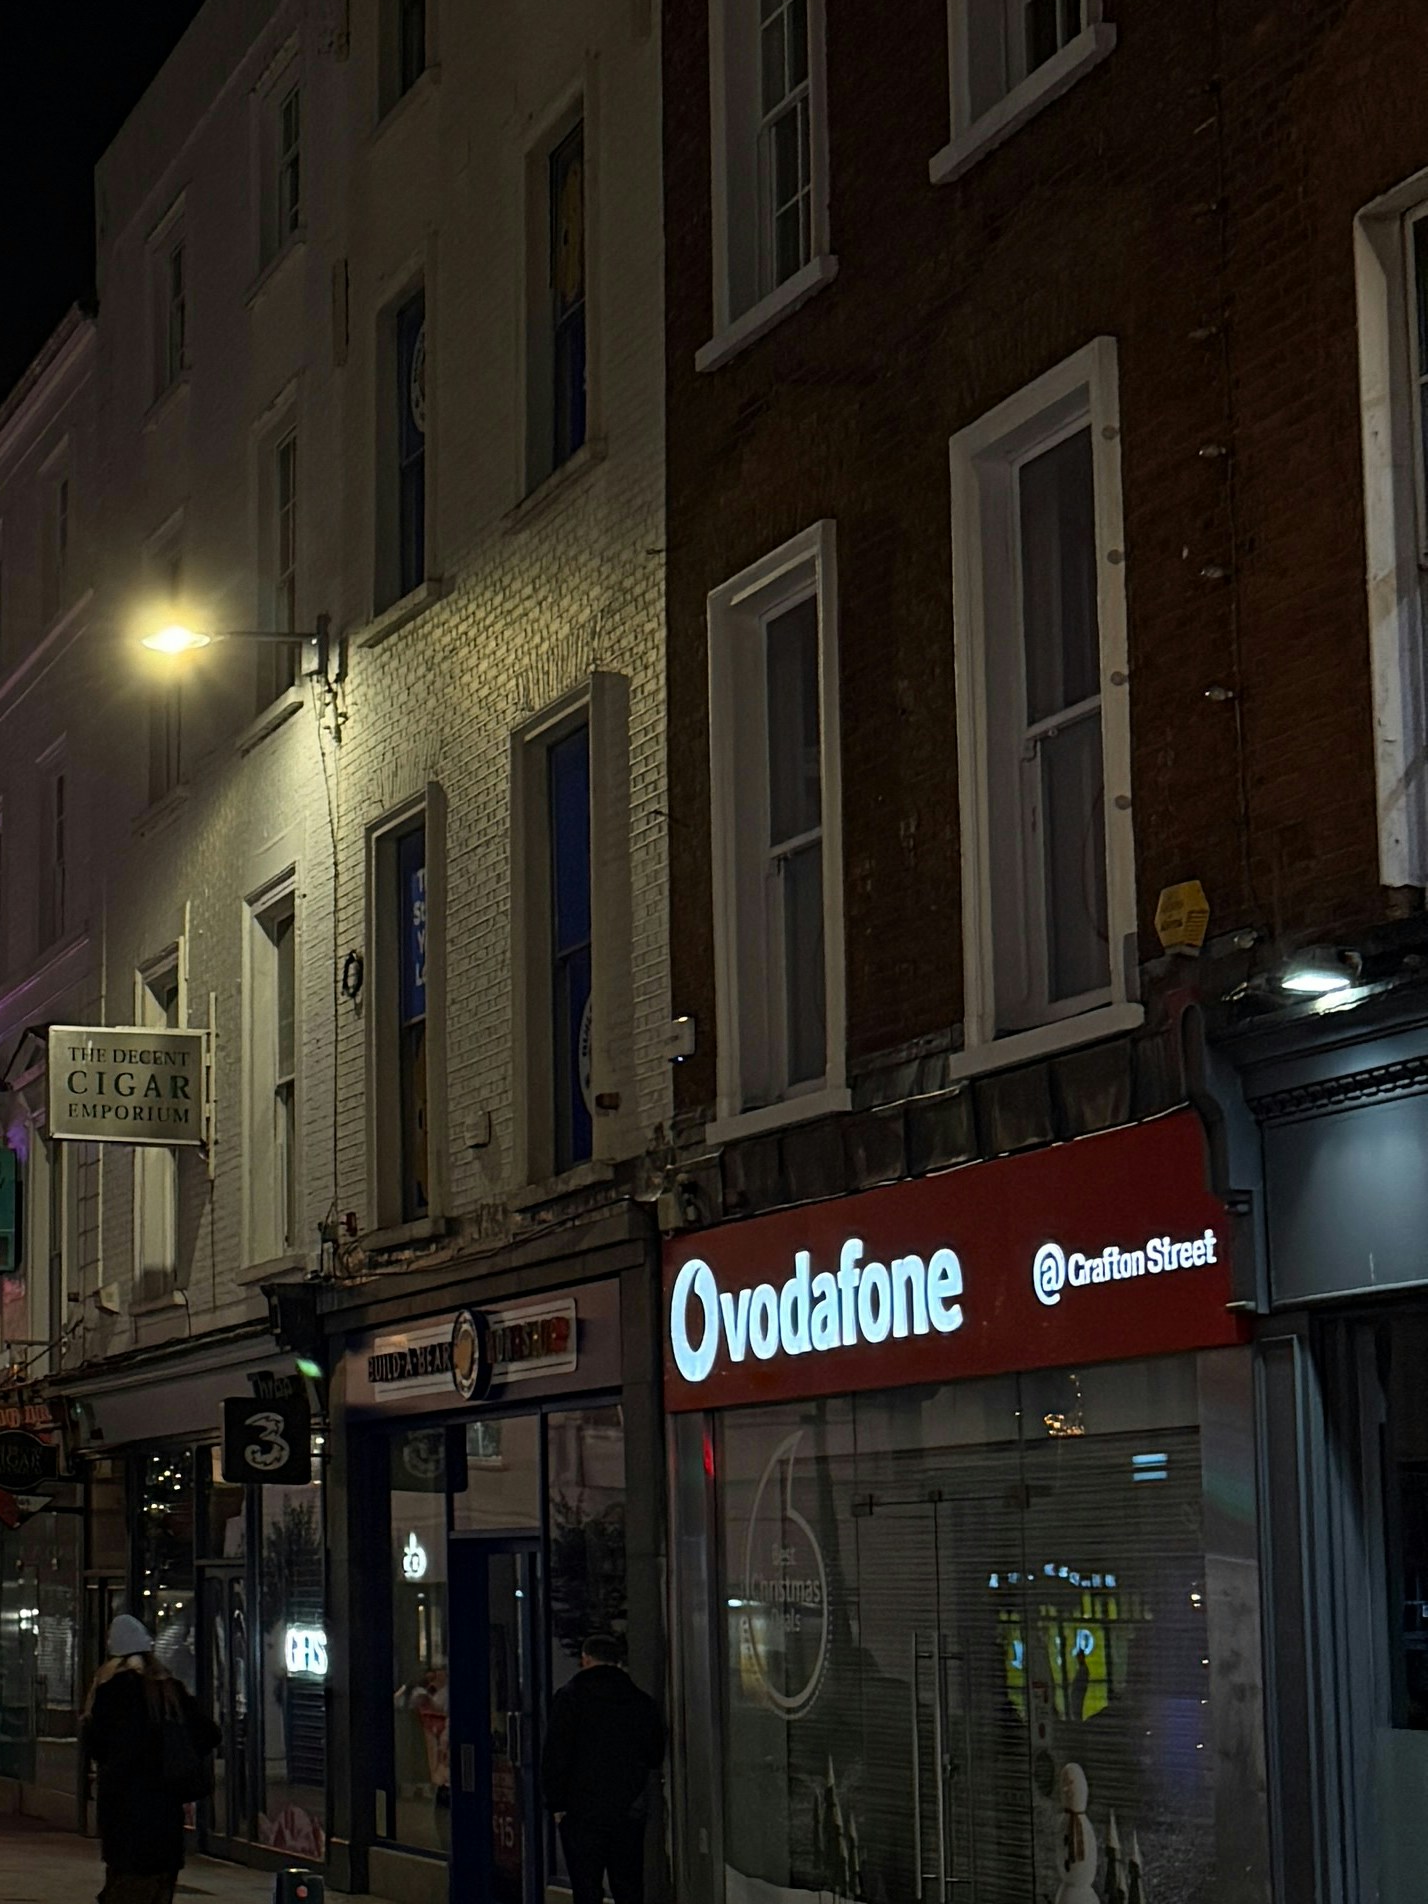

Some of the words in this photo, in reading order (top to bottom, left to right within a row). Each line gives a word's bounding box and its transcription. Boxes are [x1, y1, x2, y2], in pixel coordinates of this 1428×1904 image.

[68, 1046, 107, 1063] THE
[113, 1049, 191, 1066] DECENT
[67, 1070, 191, 1100] CIGAR
[68, 1103, 189, 1124] EMPORIUM
[1146, 1229, 1218, 1274] Street
[720, 1238, 964, 1362] vodafone
[243, 1411, 291, 1471] 3
